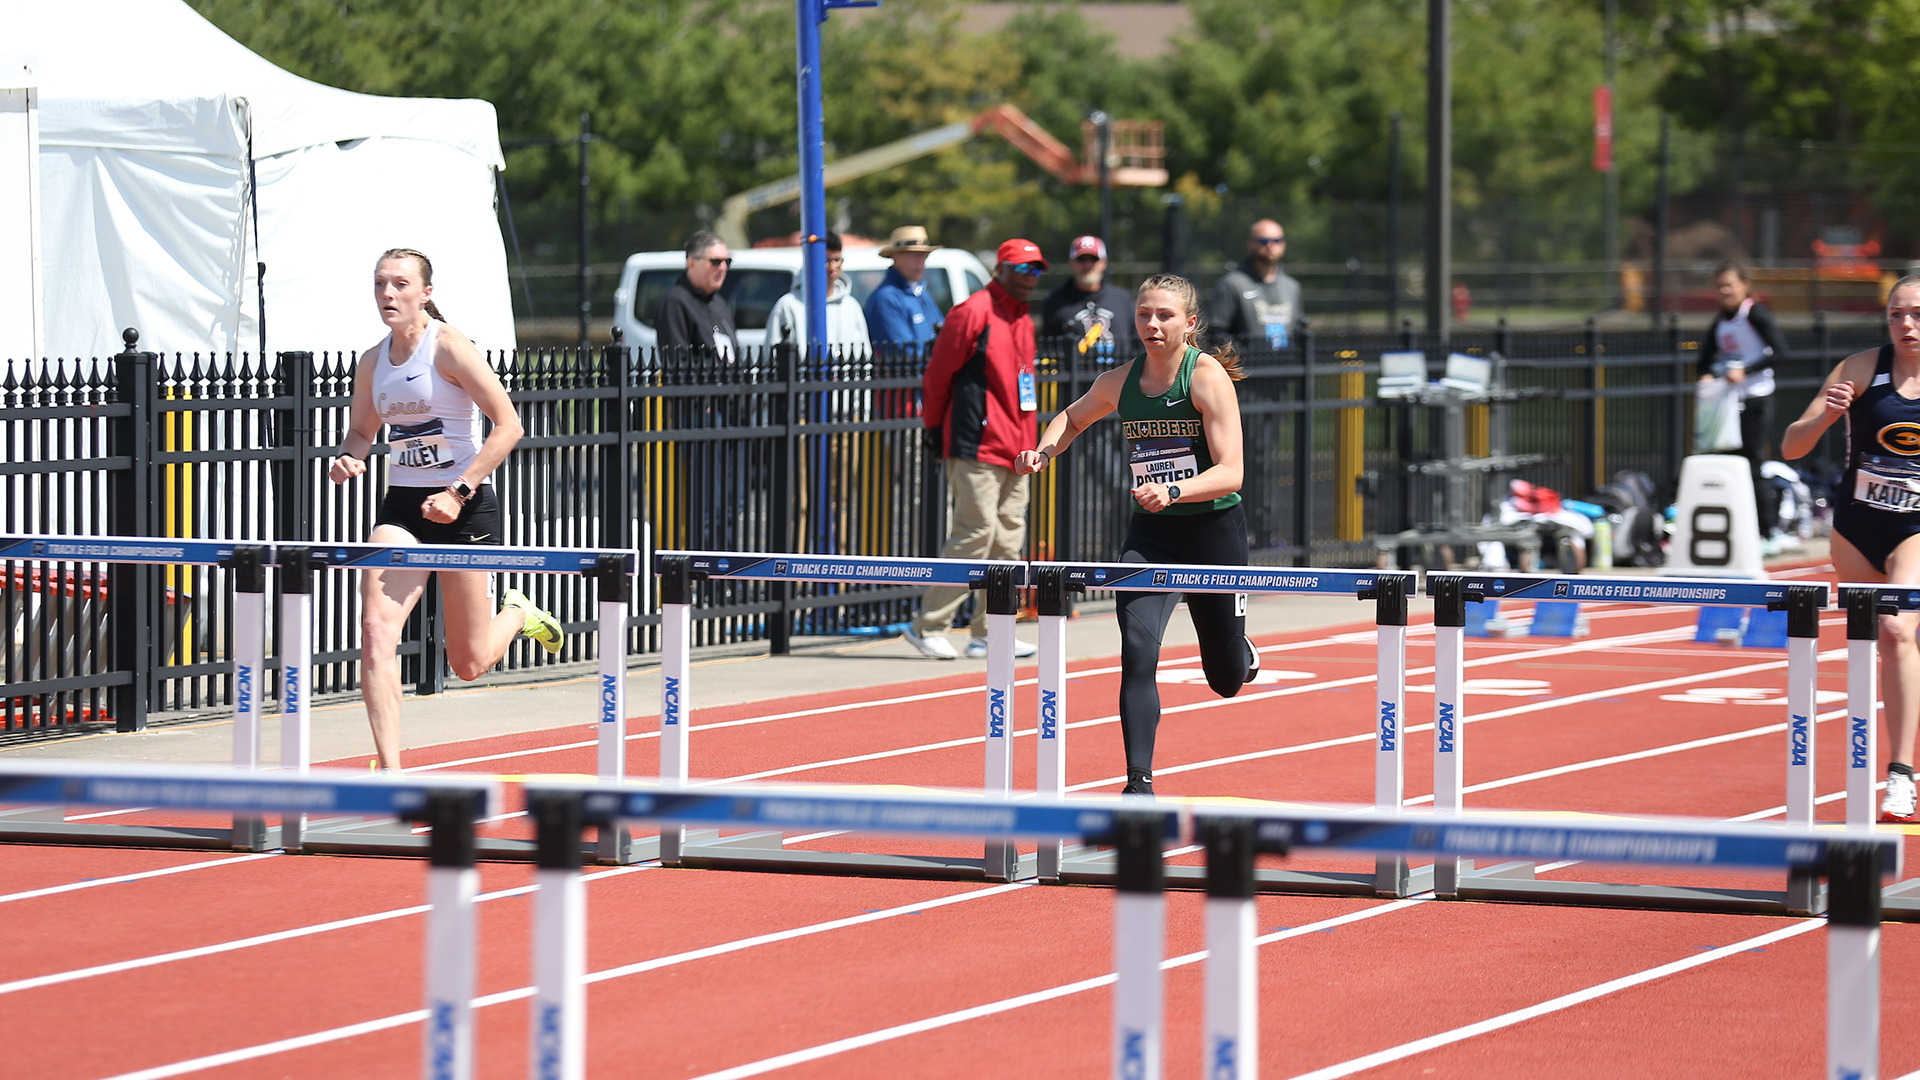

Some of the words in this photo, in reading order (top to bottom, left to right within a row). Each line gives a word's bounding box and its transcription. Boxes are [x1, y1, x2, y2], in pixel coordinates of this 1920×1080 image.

[399, 444, 438, 467] ALLEY
[1146, 461, 1175, 472] LAUREN
[48, 544, 76, 554] TRACK
[85, 545, 110, 556] FIELD
[110, 546, 184, 558] CHAMPIONSHIPS
[407, 553, 436, 564] TRACK
[438, 554, 444, 564] &
[444, 554, 469, 564] FIELD
[470, 555, 546, 566] CHAMPIONSHIPS
[1690, 506, 1731, 566] 8
[791, 563, 820, 574] TRACK
[821, 564, 828, 575] &
[829, 564, 854, 576] FIELD
[856, 565, 933, 578] CHAMPIONSHIPS
[1170, 573, 1201, 585] TRACK
[1202, 574, 1210, 585] &
[1210, 574, 1236, 586] FIELD
[1238, 575, 1319, 588] CHAMPIONSHIPS
[1572, 584, 1604, 596] TRACK
[1605, 585, 1613, 596] &
[1614, 585, 1641, 597] FIELD
[1642, 586, 1727, 600] CHAMPIONSHIPS
[238, 665, 251, 712] NCAA
[284, 666, 298, 714] NCAA
[602, 674, 616, 722] NCAA
[665, 676, 678, 725] NCAA
[990, 688, 1004, 738] NCAA
[1042, 689, 1056, 739] NCAA
[1381, 701, 1395, 751] NCAA
[1439, 702, 1453, 752] NCAA
[1792, 714, 1807, 765] NCAA
[1852, 717, 1867, 768] NCAA
